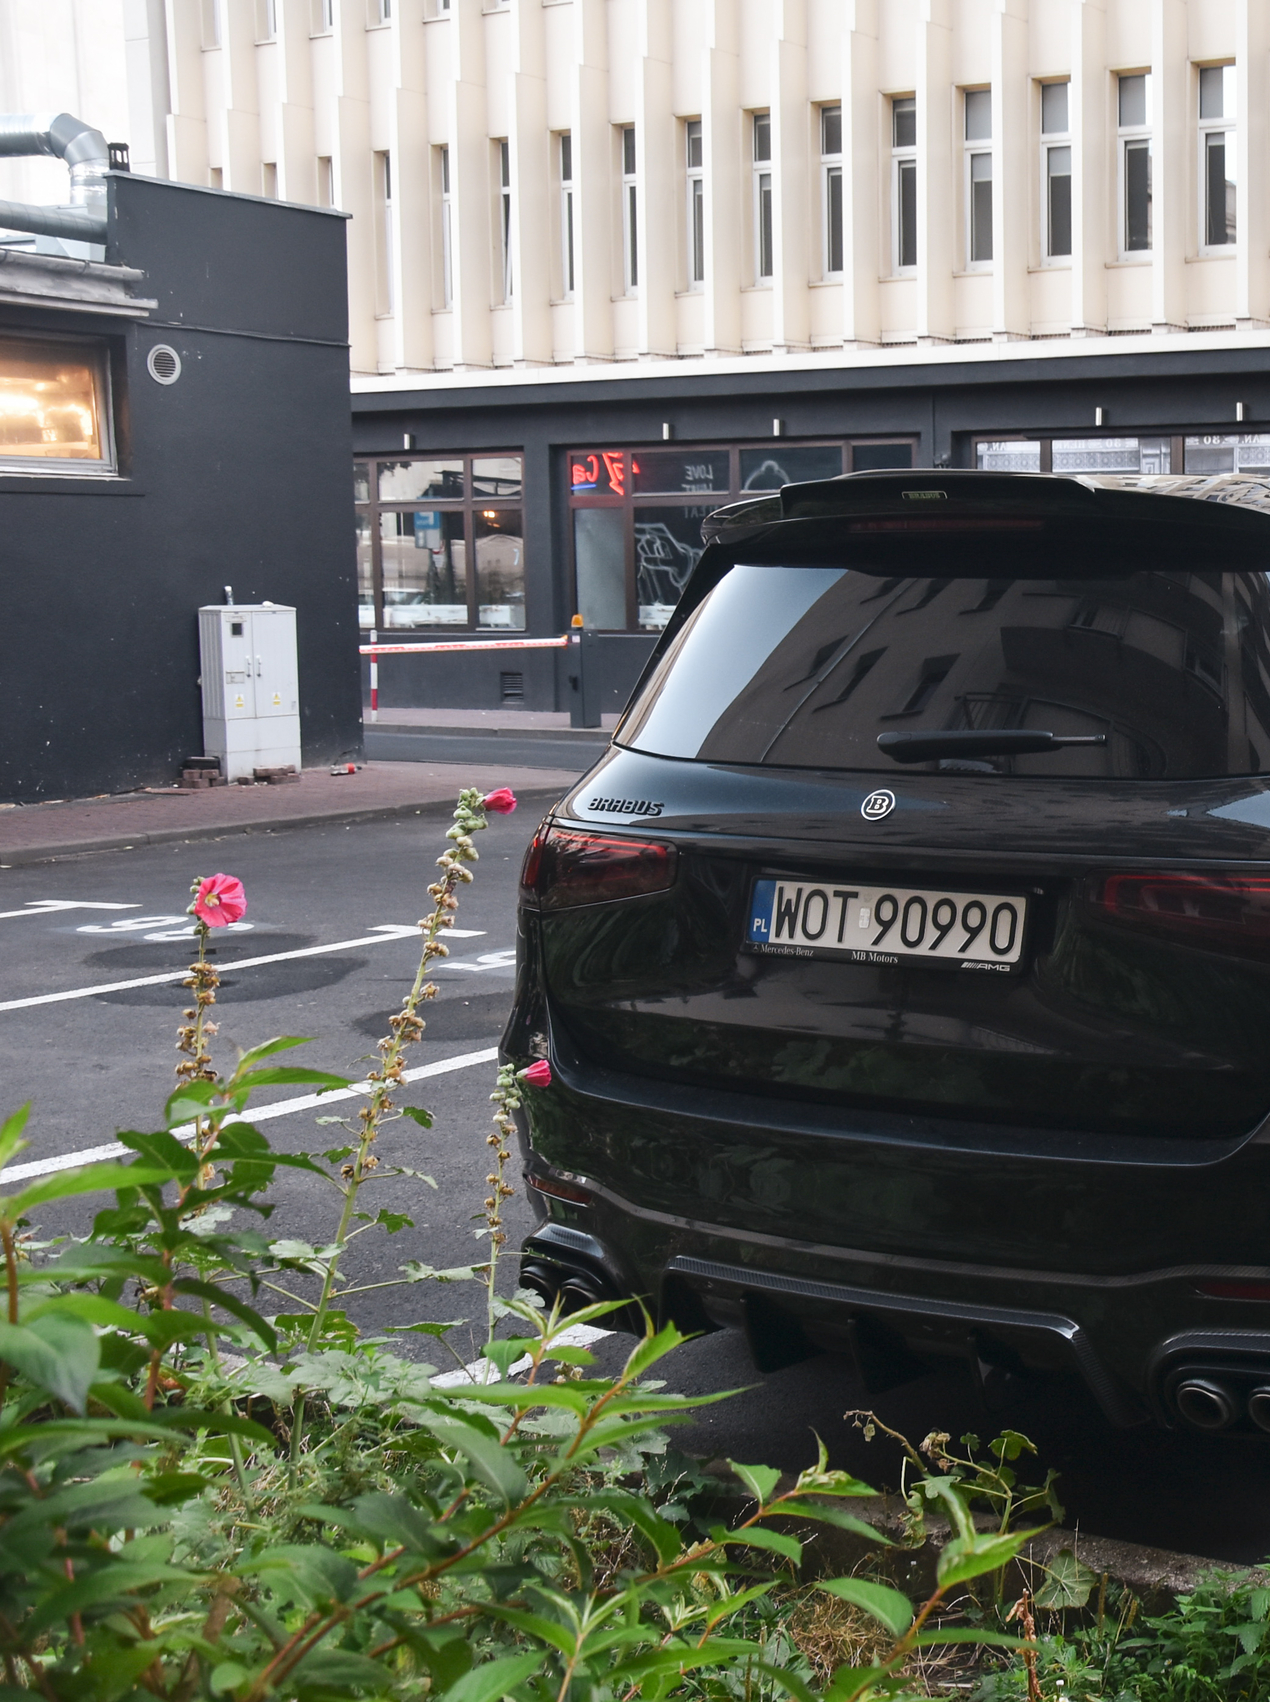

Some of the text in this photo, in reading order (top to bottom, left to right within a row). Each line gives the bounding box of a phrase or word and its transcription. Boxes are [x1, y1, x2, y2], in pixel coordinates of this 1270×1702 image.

[587, 797, 665, 816] BRABUS
[753, 917, 768, 933] PL
[774, 886, 1018, 956] WOT 90990
[760, 944, 815, 958] Mercedes-Benz
[851, 950, 899, 965] MB Motors
[976, 962, 1011, 972] AMG
